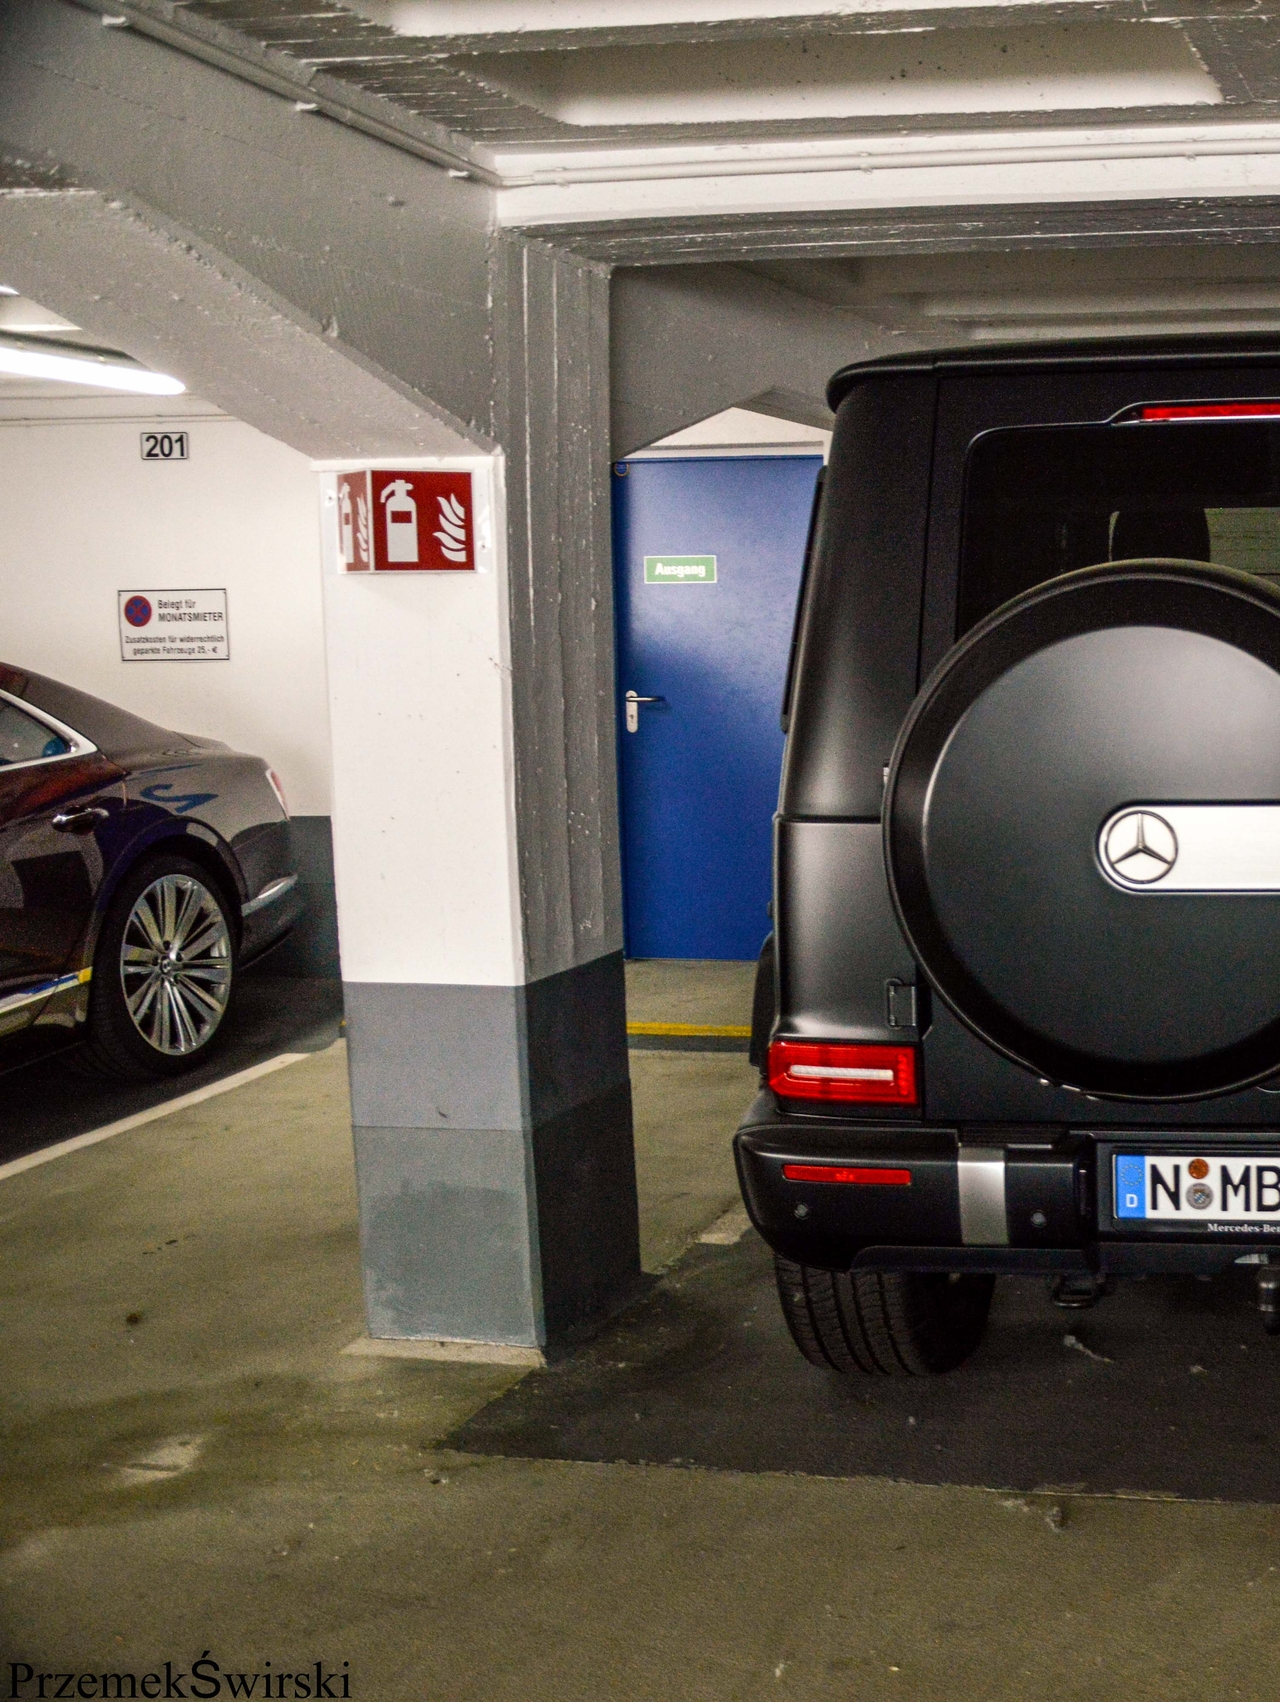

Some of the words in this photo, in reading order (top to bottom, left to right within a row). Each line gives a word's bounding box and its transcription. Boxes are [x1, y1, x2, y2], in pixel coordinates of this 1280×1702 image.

[145, 434, 186, 458] 201
[654, 562, 706, 578] Ausgang
[157, 599, 183, 611] Belegt
[185, 598, 197, 609] für
[158, 611, 224, 622] MONATSMIETER
[125, 635, 167, 644] Zusatzkosten
[168, 635, 177, 643] für
[179, 634, 225, 643] widerrechtlich
[132, 646, 161, 656] geparkte
[162, 646, 196, 655] Fahrzeuge
[1150, 1163, 1181, 1211] N
[1125, 1193, 1138, 1208] D
